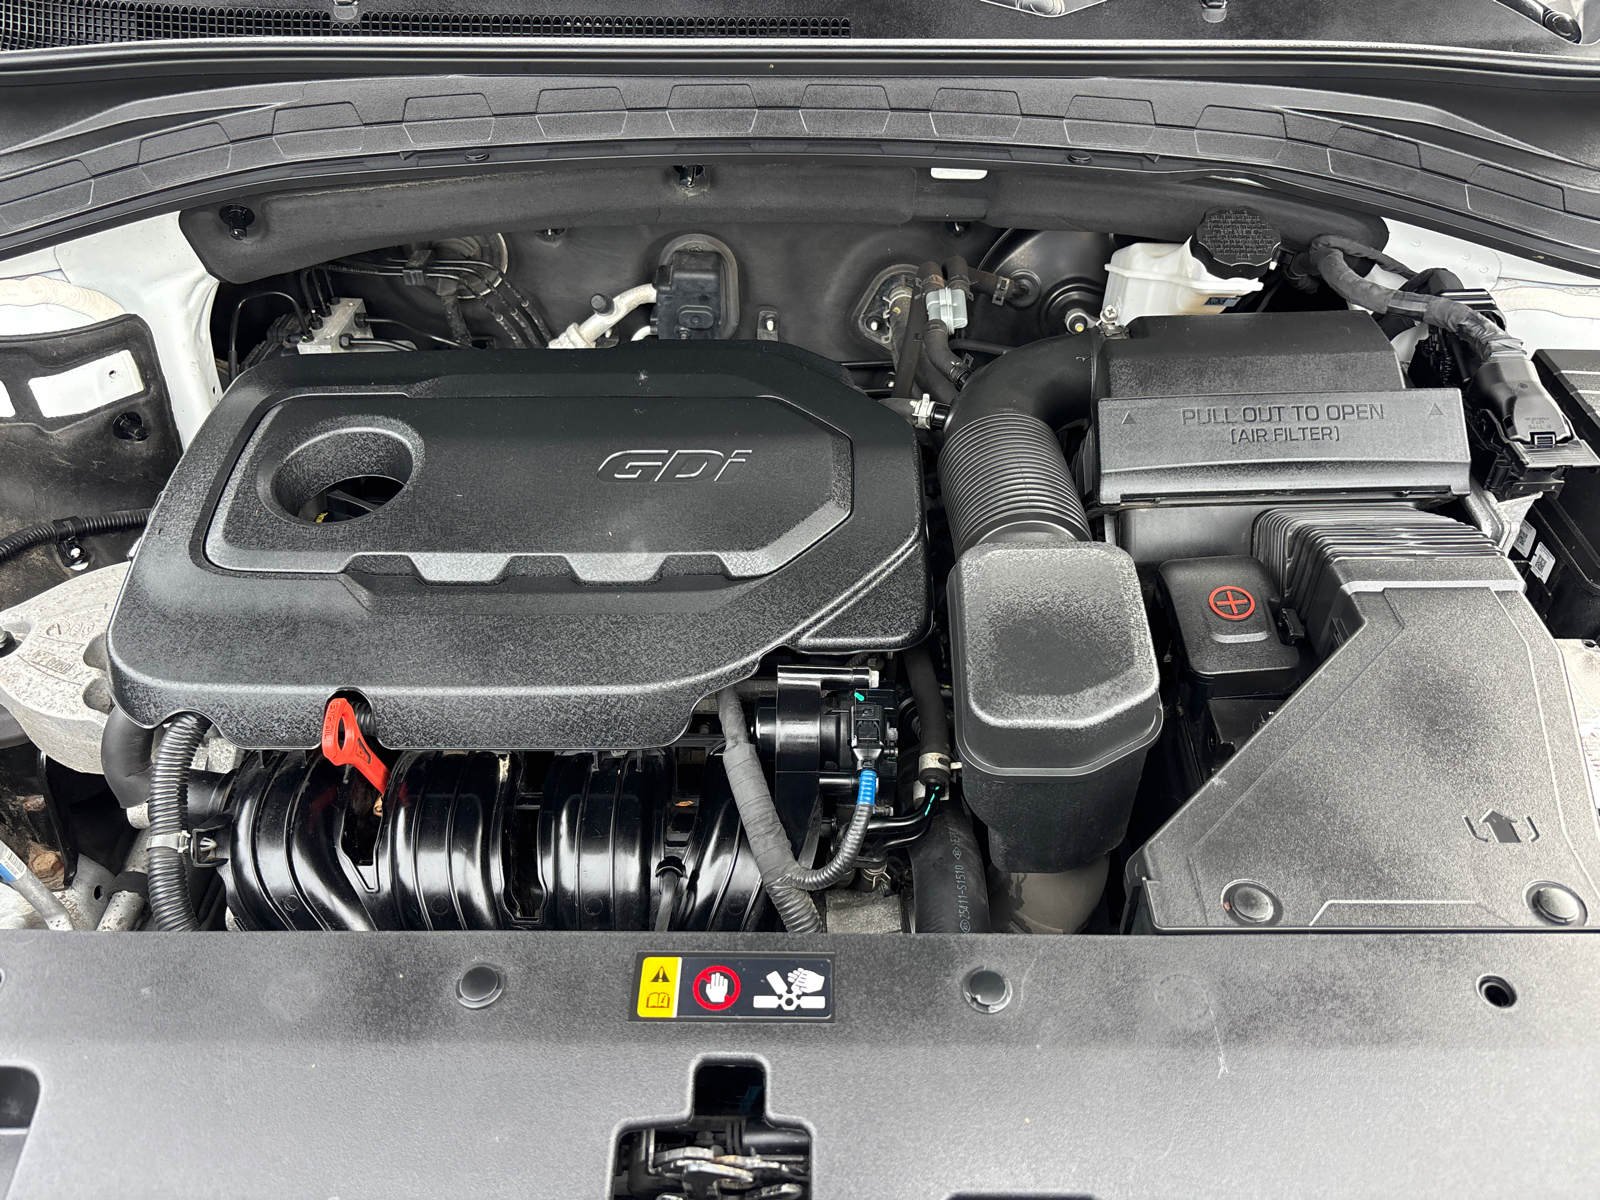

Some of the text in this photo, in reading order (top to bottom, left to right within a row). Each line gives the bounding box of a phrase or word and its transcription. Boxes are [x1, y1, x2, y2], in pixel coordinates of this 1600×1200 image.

[1180, 403, 1385, 425] PULL OUT TO OPEN
[324, 703, 338, 740] ENG OIL
[954, 864, 971, 920] 25411-S1510
